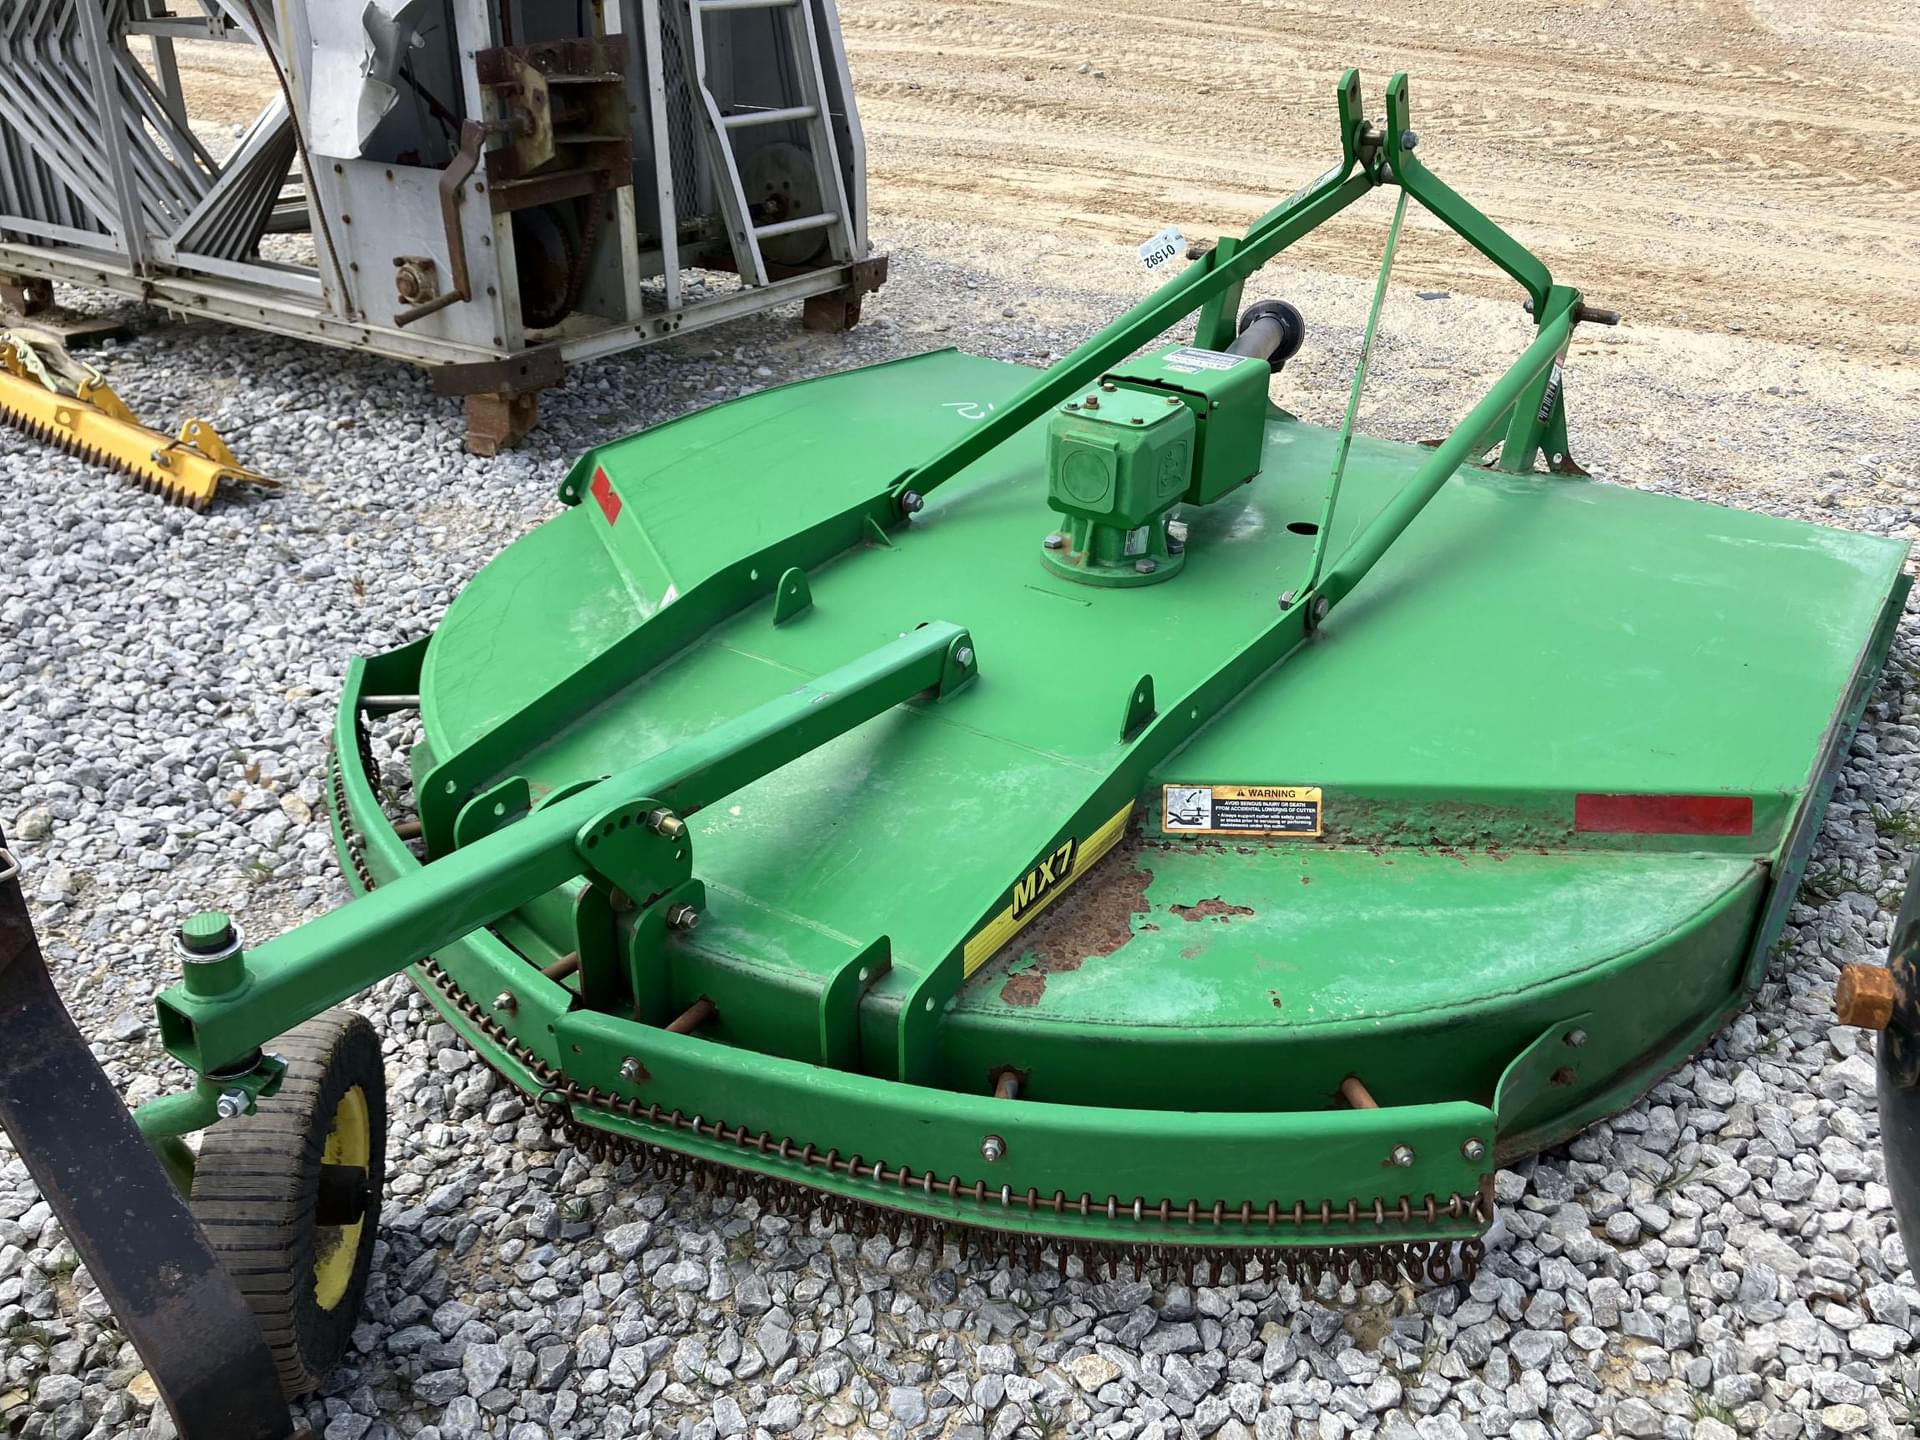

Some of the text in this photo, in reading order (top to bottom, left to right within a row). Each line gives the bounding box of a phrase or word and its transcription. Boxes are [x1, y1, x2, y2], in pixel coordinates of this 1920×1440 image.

[1144, 244, 1176, 269] 01592
[1248, 789, 1296, 798] WARNING
[1012, 838, 1074, 917] MX7
